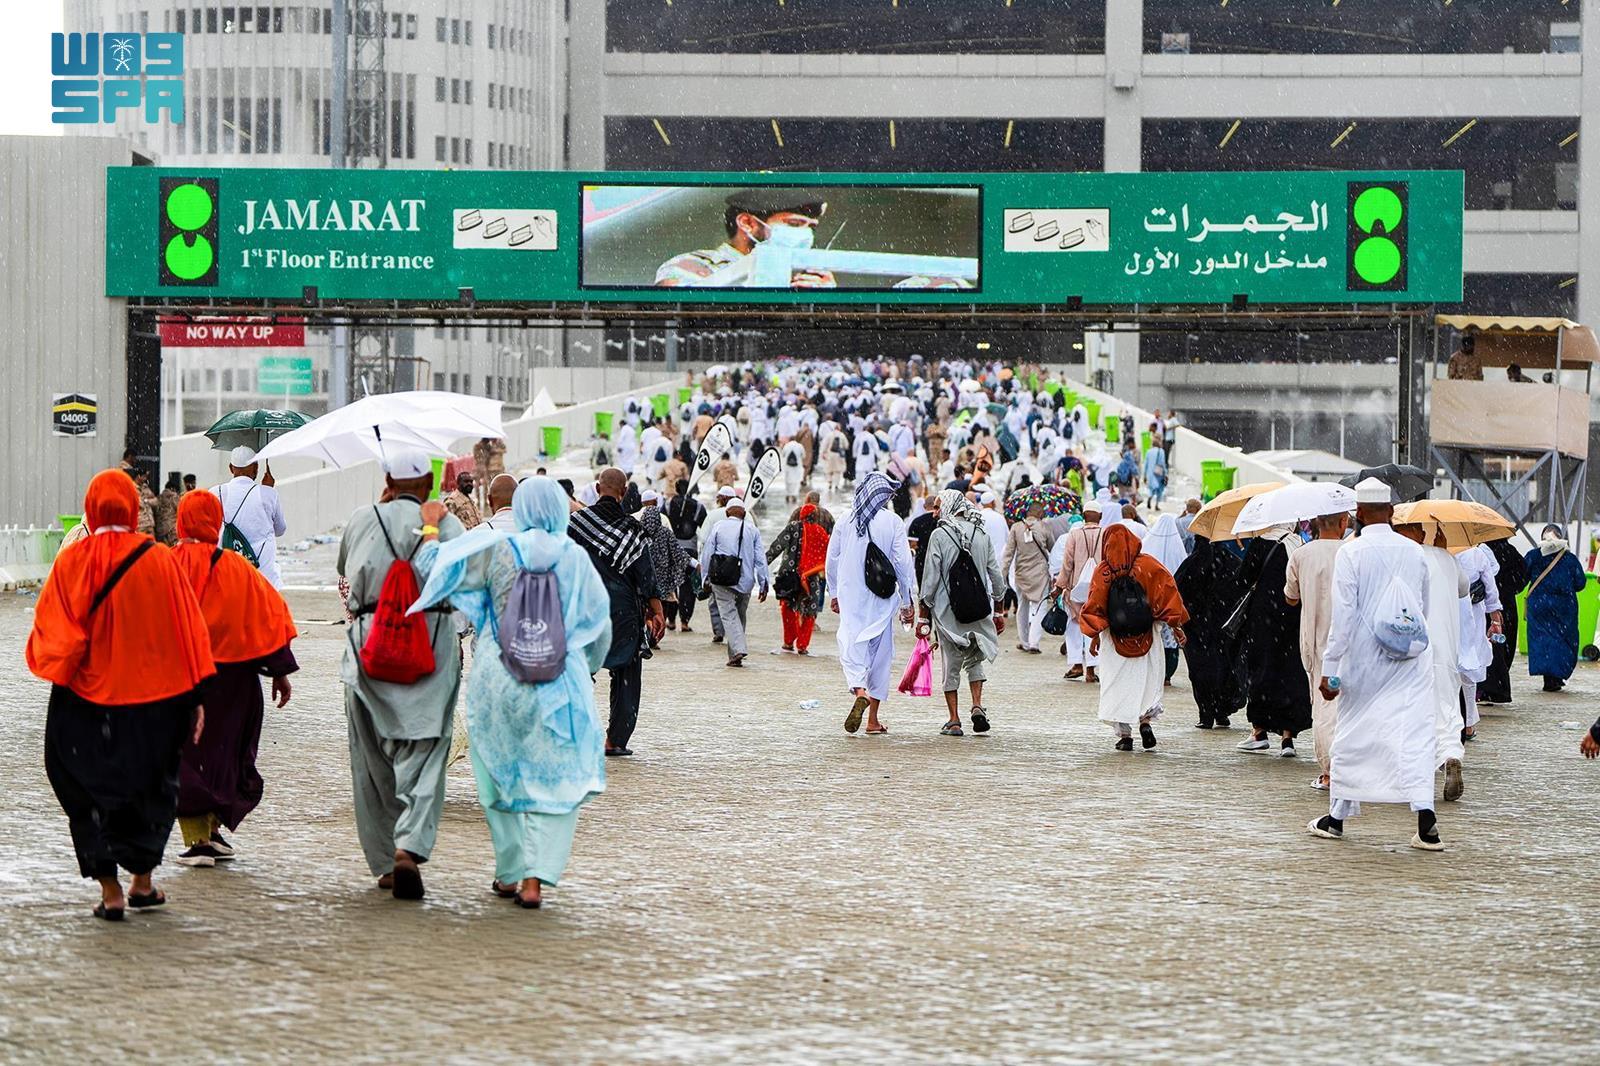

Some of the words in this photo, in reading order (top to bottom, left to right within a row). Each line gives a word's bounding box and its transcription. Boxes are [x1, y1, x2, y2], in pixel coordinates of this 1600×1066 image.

[237, 198, 426, 235] JAMARAT
[1144, 199, 1328, 242] الجمرات
[265, 249, 326, 269] Floor
[329, 250, 435, 270] Entrance
[1124, 246, 1180, 276] الأول
[1189, 250, 1249, 276] الدور
[1254, 249, 1328, 273] مدخل
[186, 326, 209, 340] NO
[212, 326, 250, 340] WAY
[253, 326, 275, 340] UP
[61, 413, 89, 423] 04005
[698, 451, 709, 466] 29
[752, 480, 762, 494] 32
